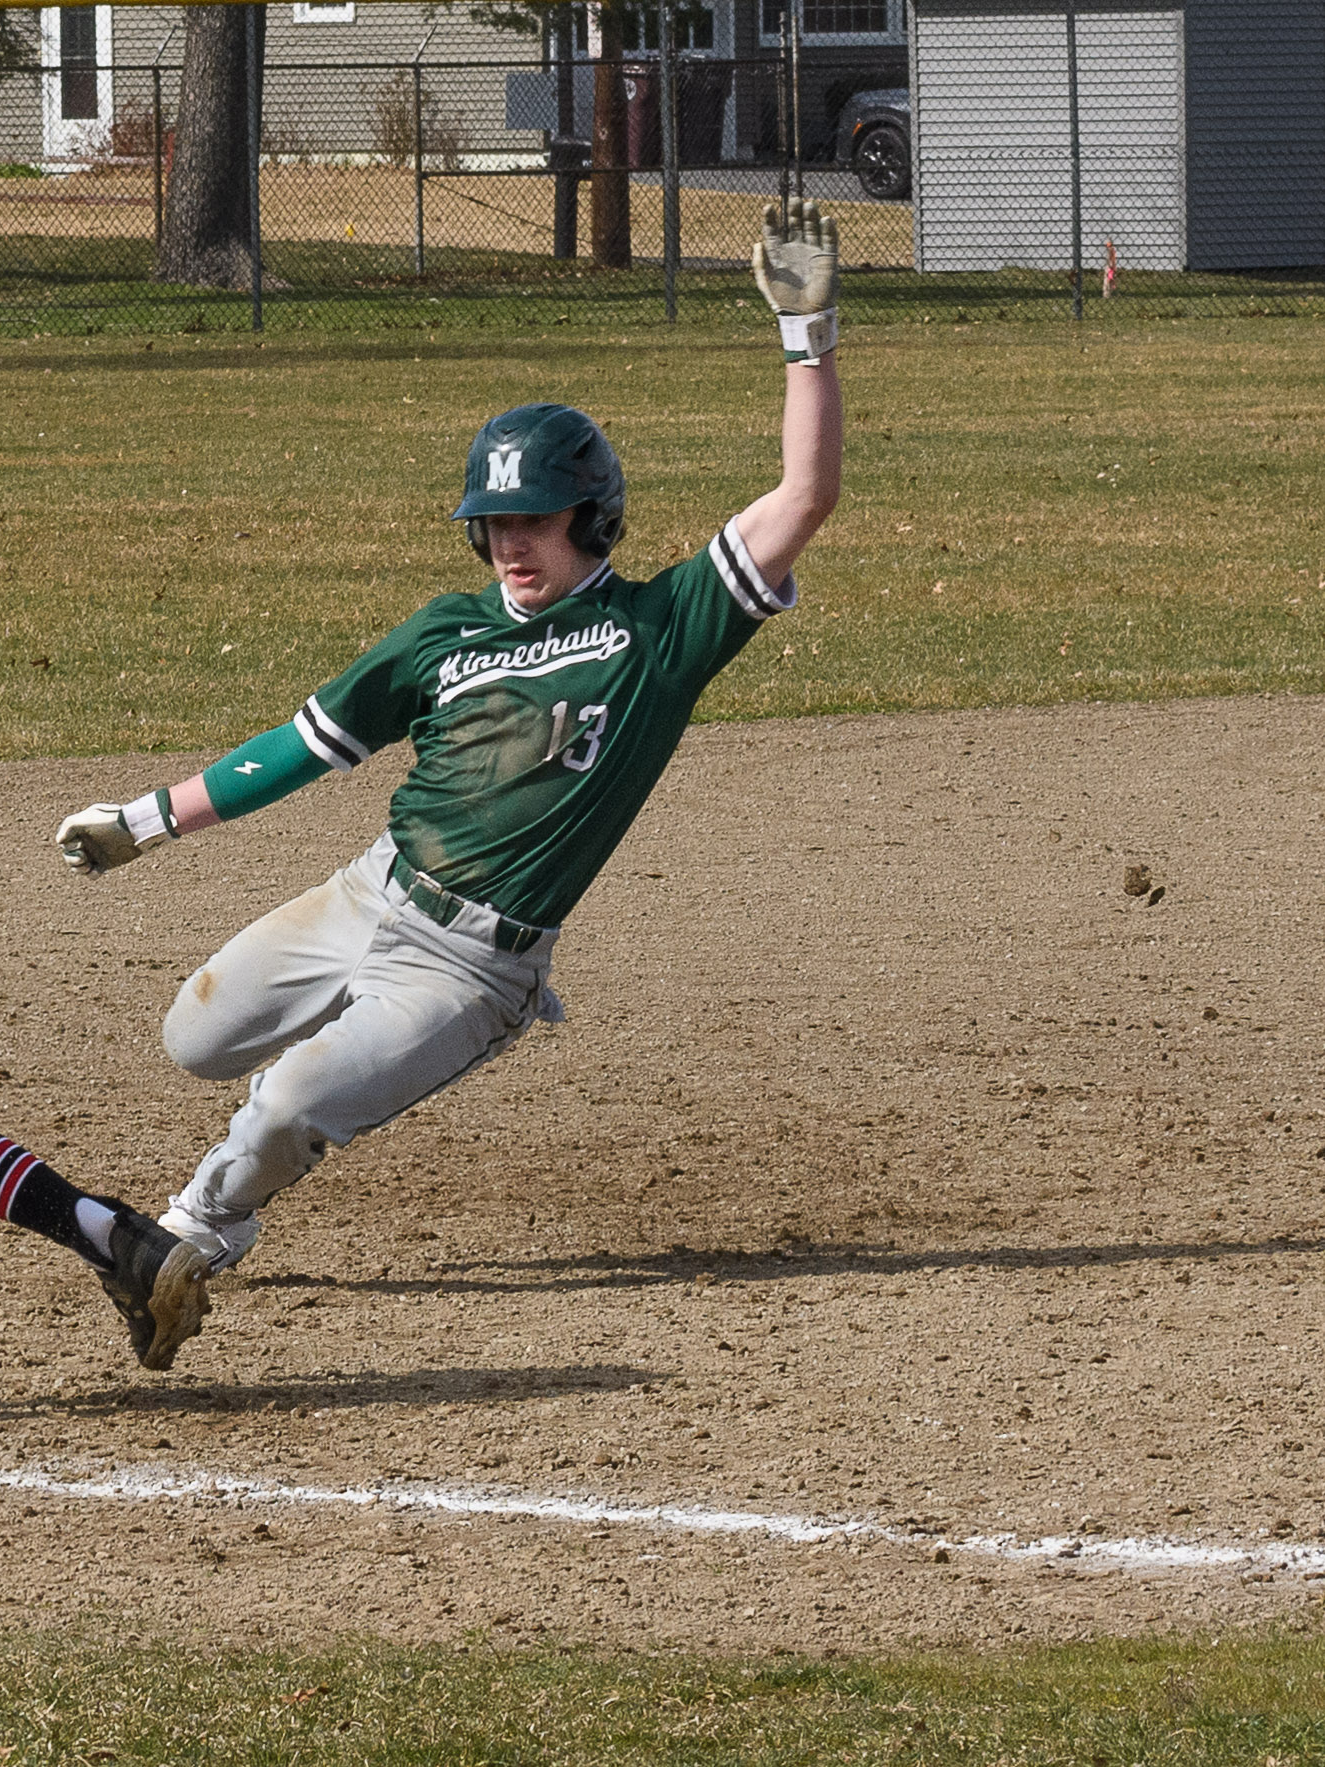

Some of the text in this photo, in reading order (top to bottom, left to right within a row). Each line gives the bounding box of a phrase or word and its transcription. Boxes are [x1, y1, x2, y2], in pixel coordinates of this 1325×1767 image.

[486, 450, 523, 491] M
[435, 619, 631, 695] Minnechaug
[543, 700, 608, 773] 13
